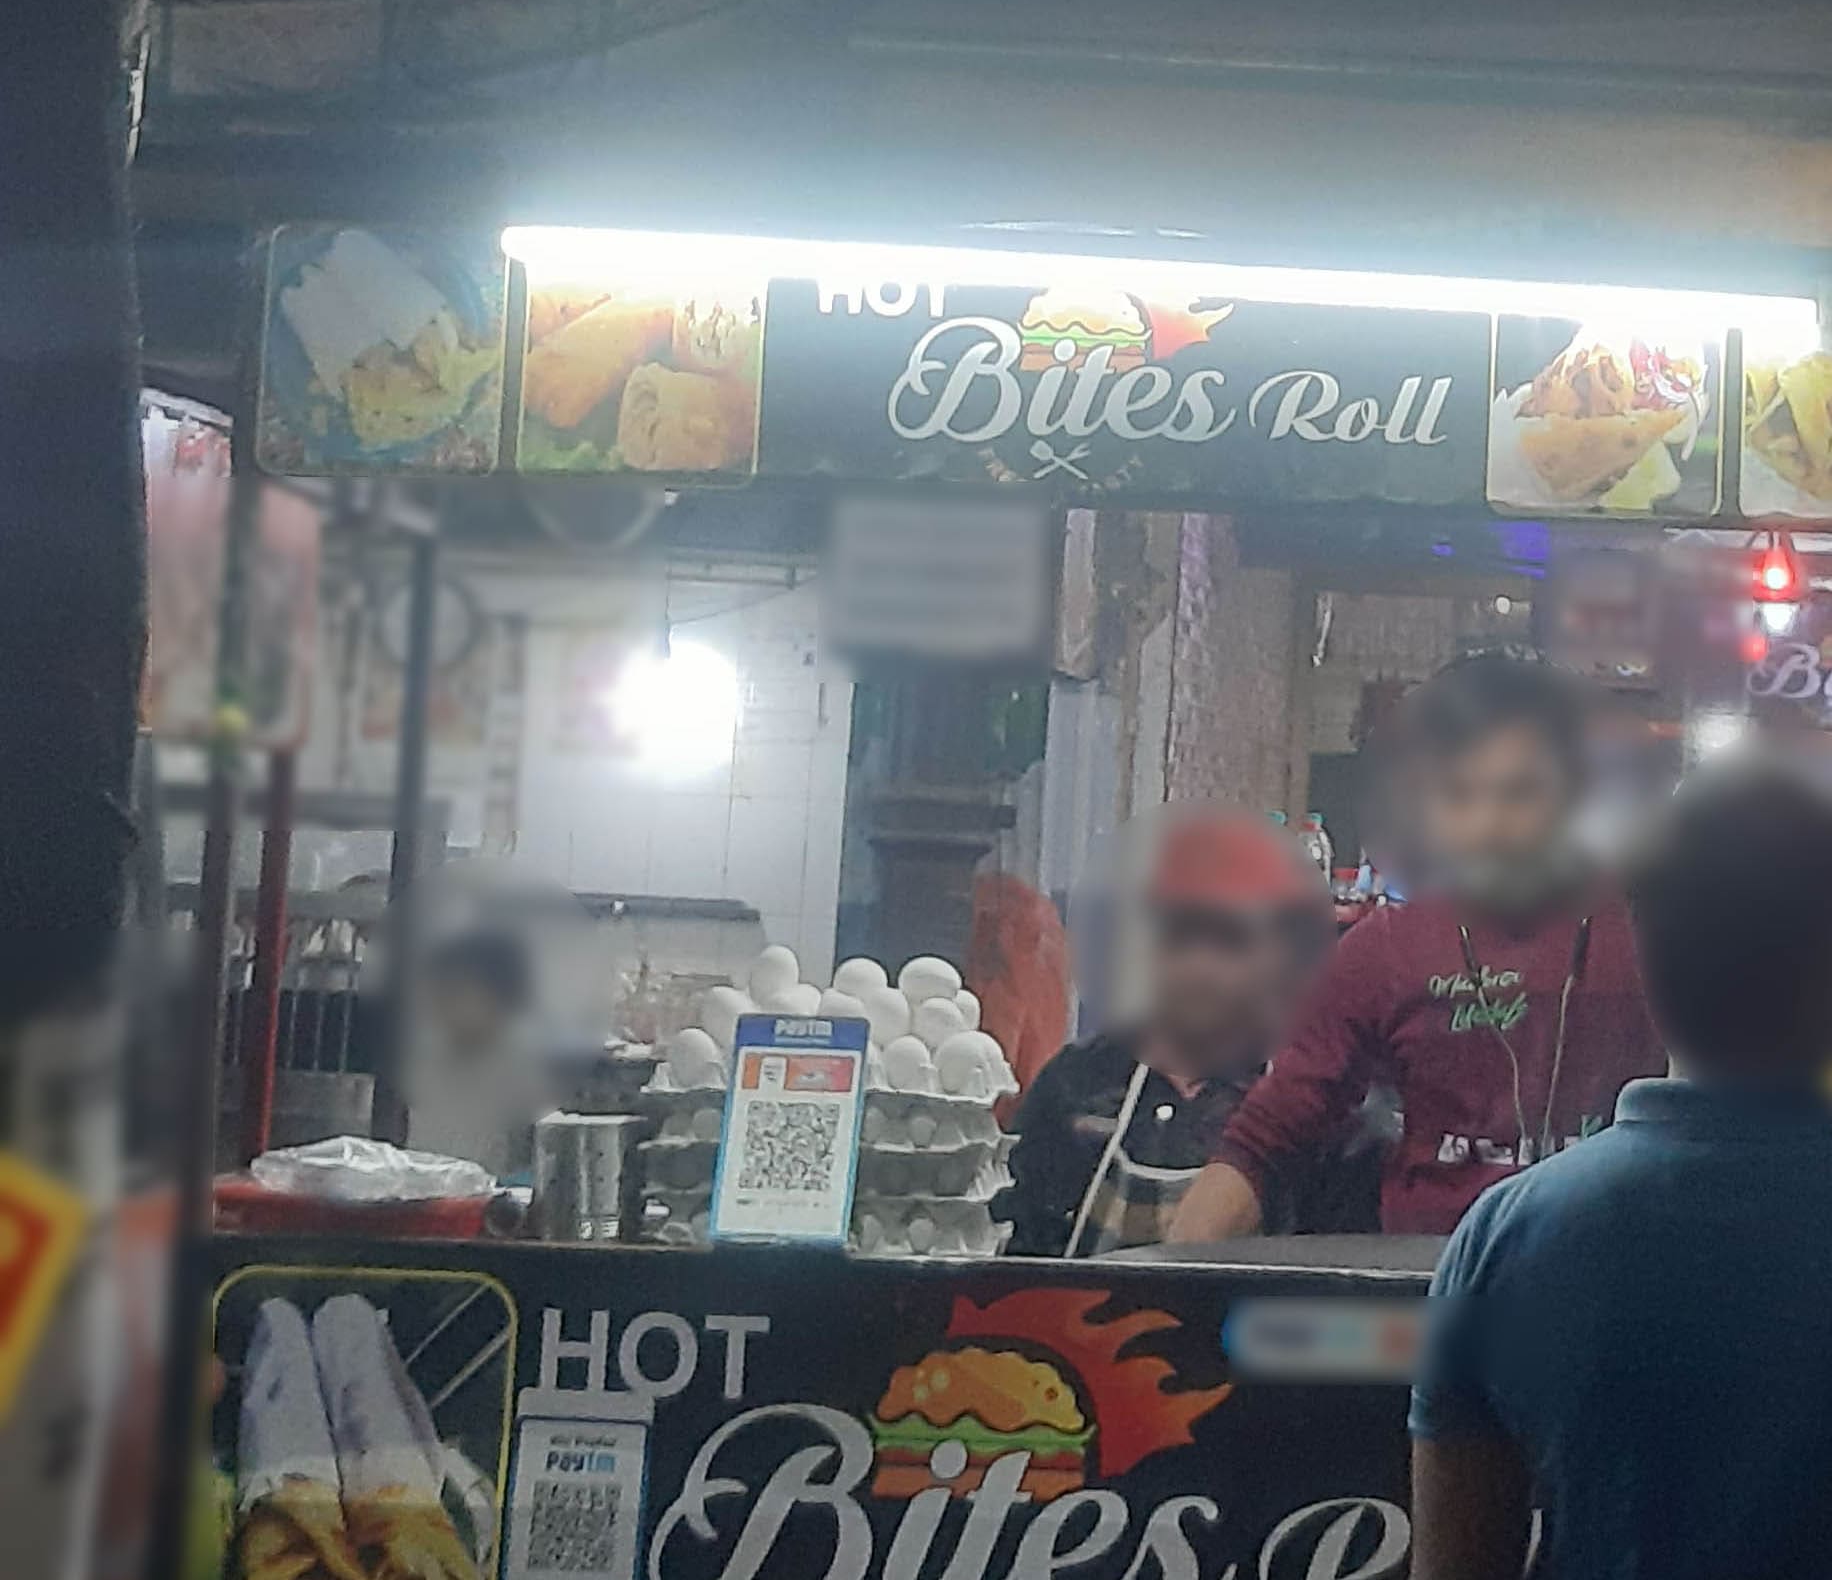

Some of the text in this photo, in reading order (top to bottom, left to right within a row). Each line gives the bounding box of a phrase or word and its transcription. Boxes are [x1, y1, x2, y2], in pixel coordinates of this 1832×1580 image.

[887, 317, 1453, 445] Bites Roll
[540, 1308, 771, 1399] HOT
